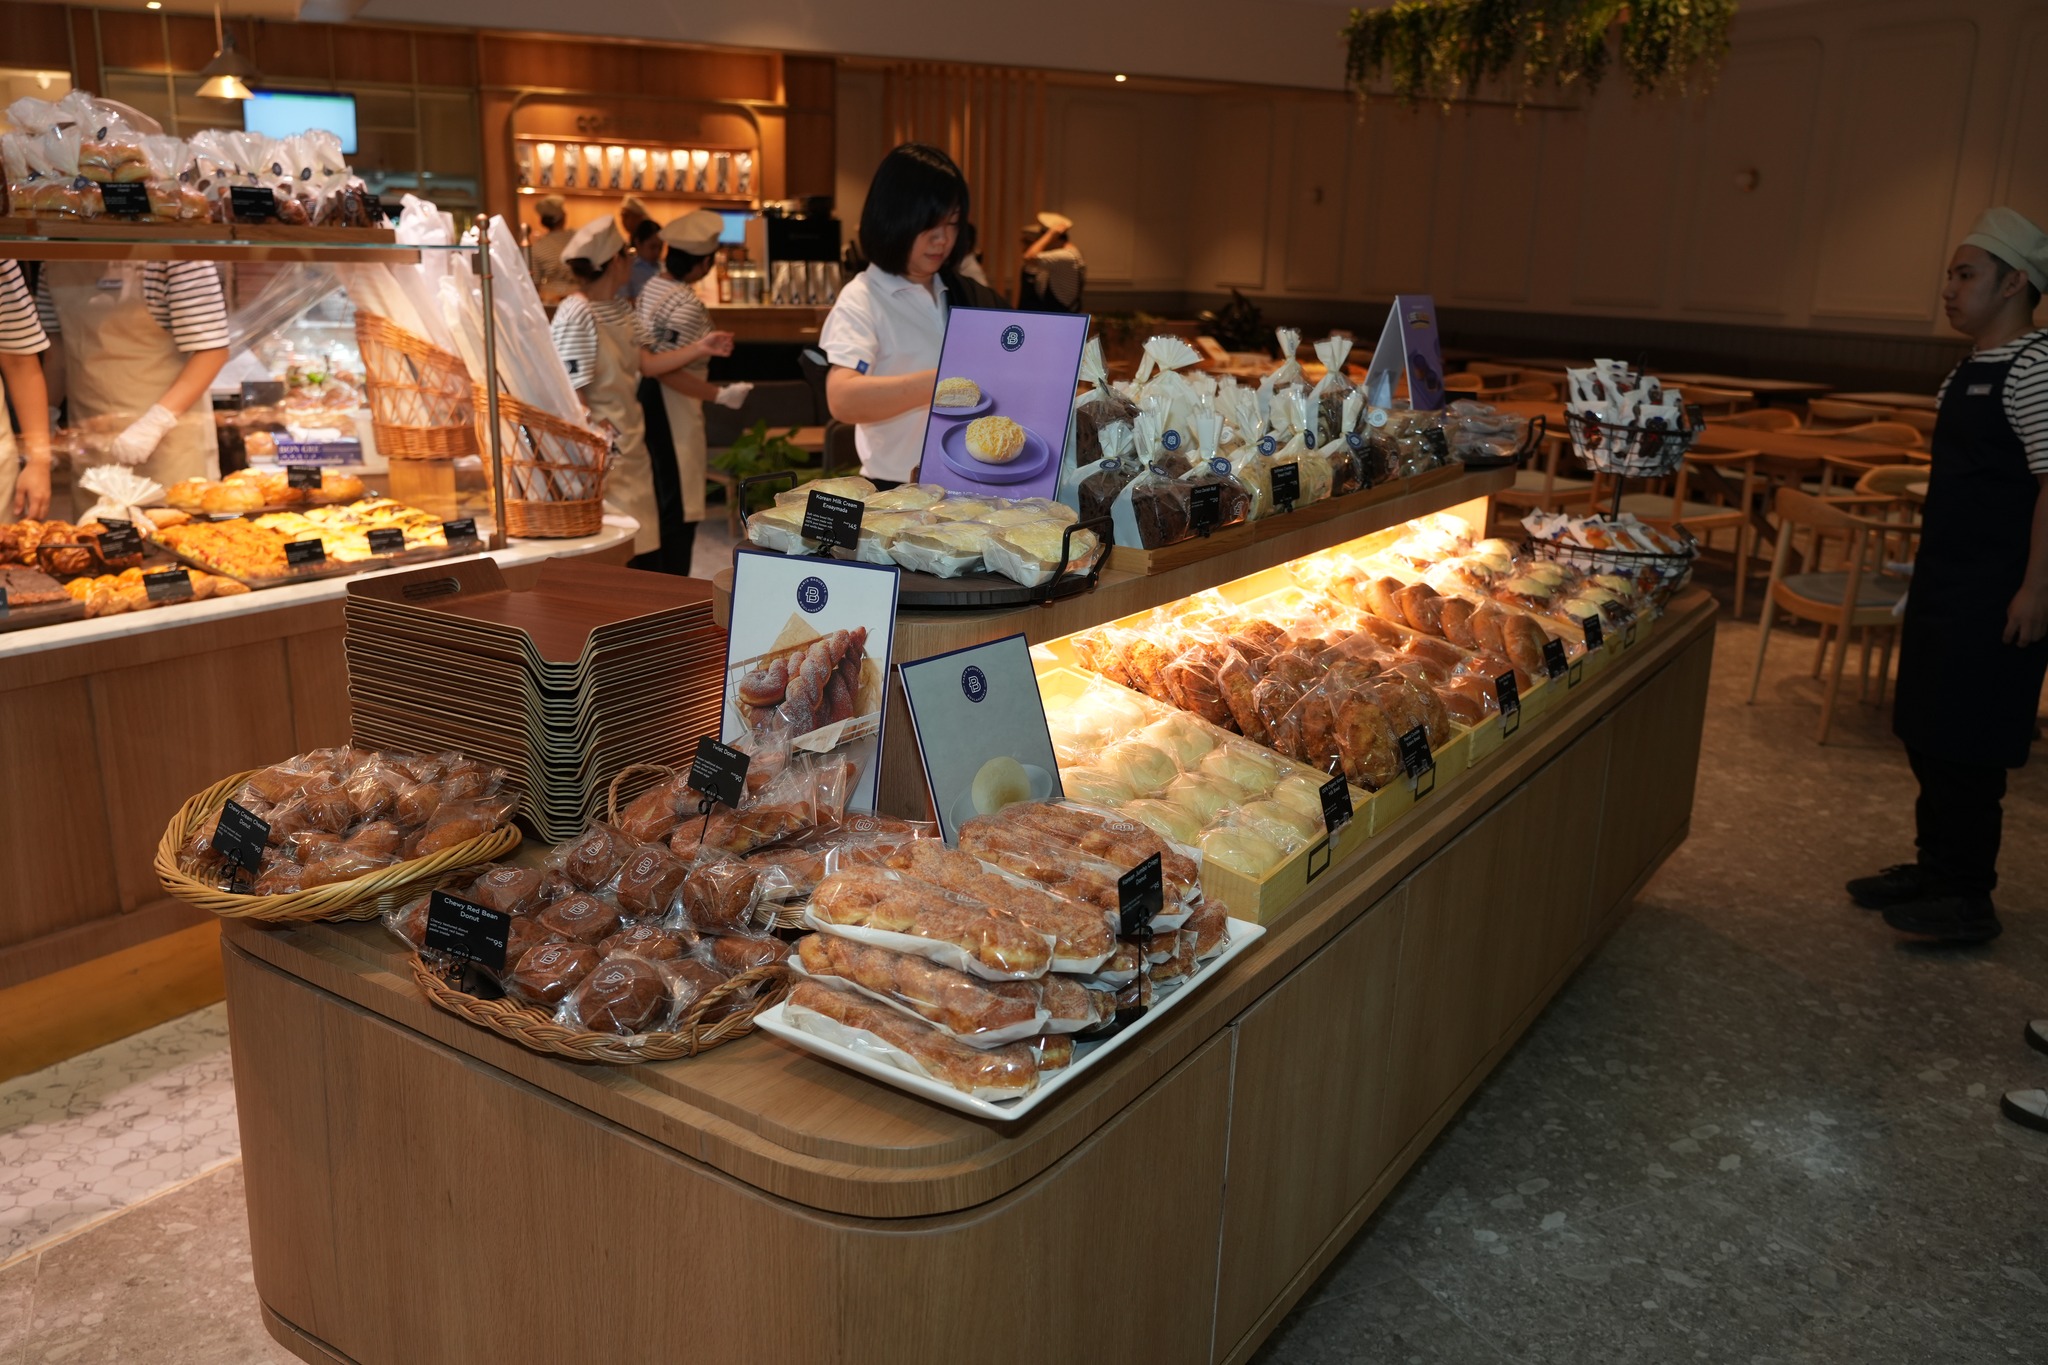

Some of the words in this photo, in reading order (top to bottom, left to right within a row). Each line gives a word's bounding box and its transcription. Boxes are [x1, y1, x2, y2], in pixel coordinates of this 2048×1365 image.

[815, 493, 831, 502] Korean
[842, 500, 858, 508] Cream
[822, 502, 848, 513] Ensaymada
[713, 743, 723, 753] Twist
[723, 749, 737, 759] Donut
[228, 803, 240, 815] Chewy
[240, 811, 253, 822] Cream
[252, 819, 267, 832] Cheese
[238, 818, 251, 830] Donut
[444, 897, 465, 910] Chewy
[466, 904, 480, 914] Red
[481, 909, 498, 920] Bean
[460, 910, 480, 923] Donut
